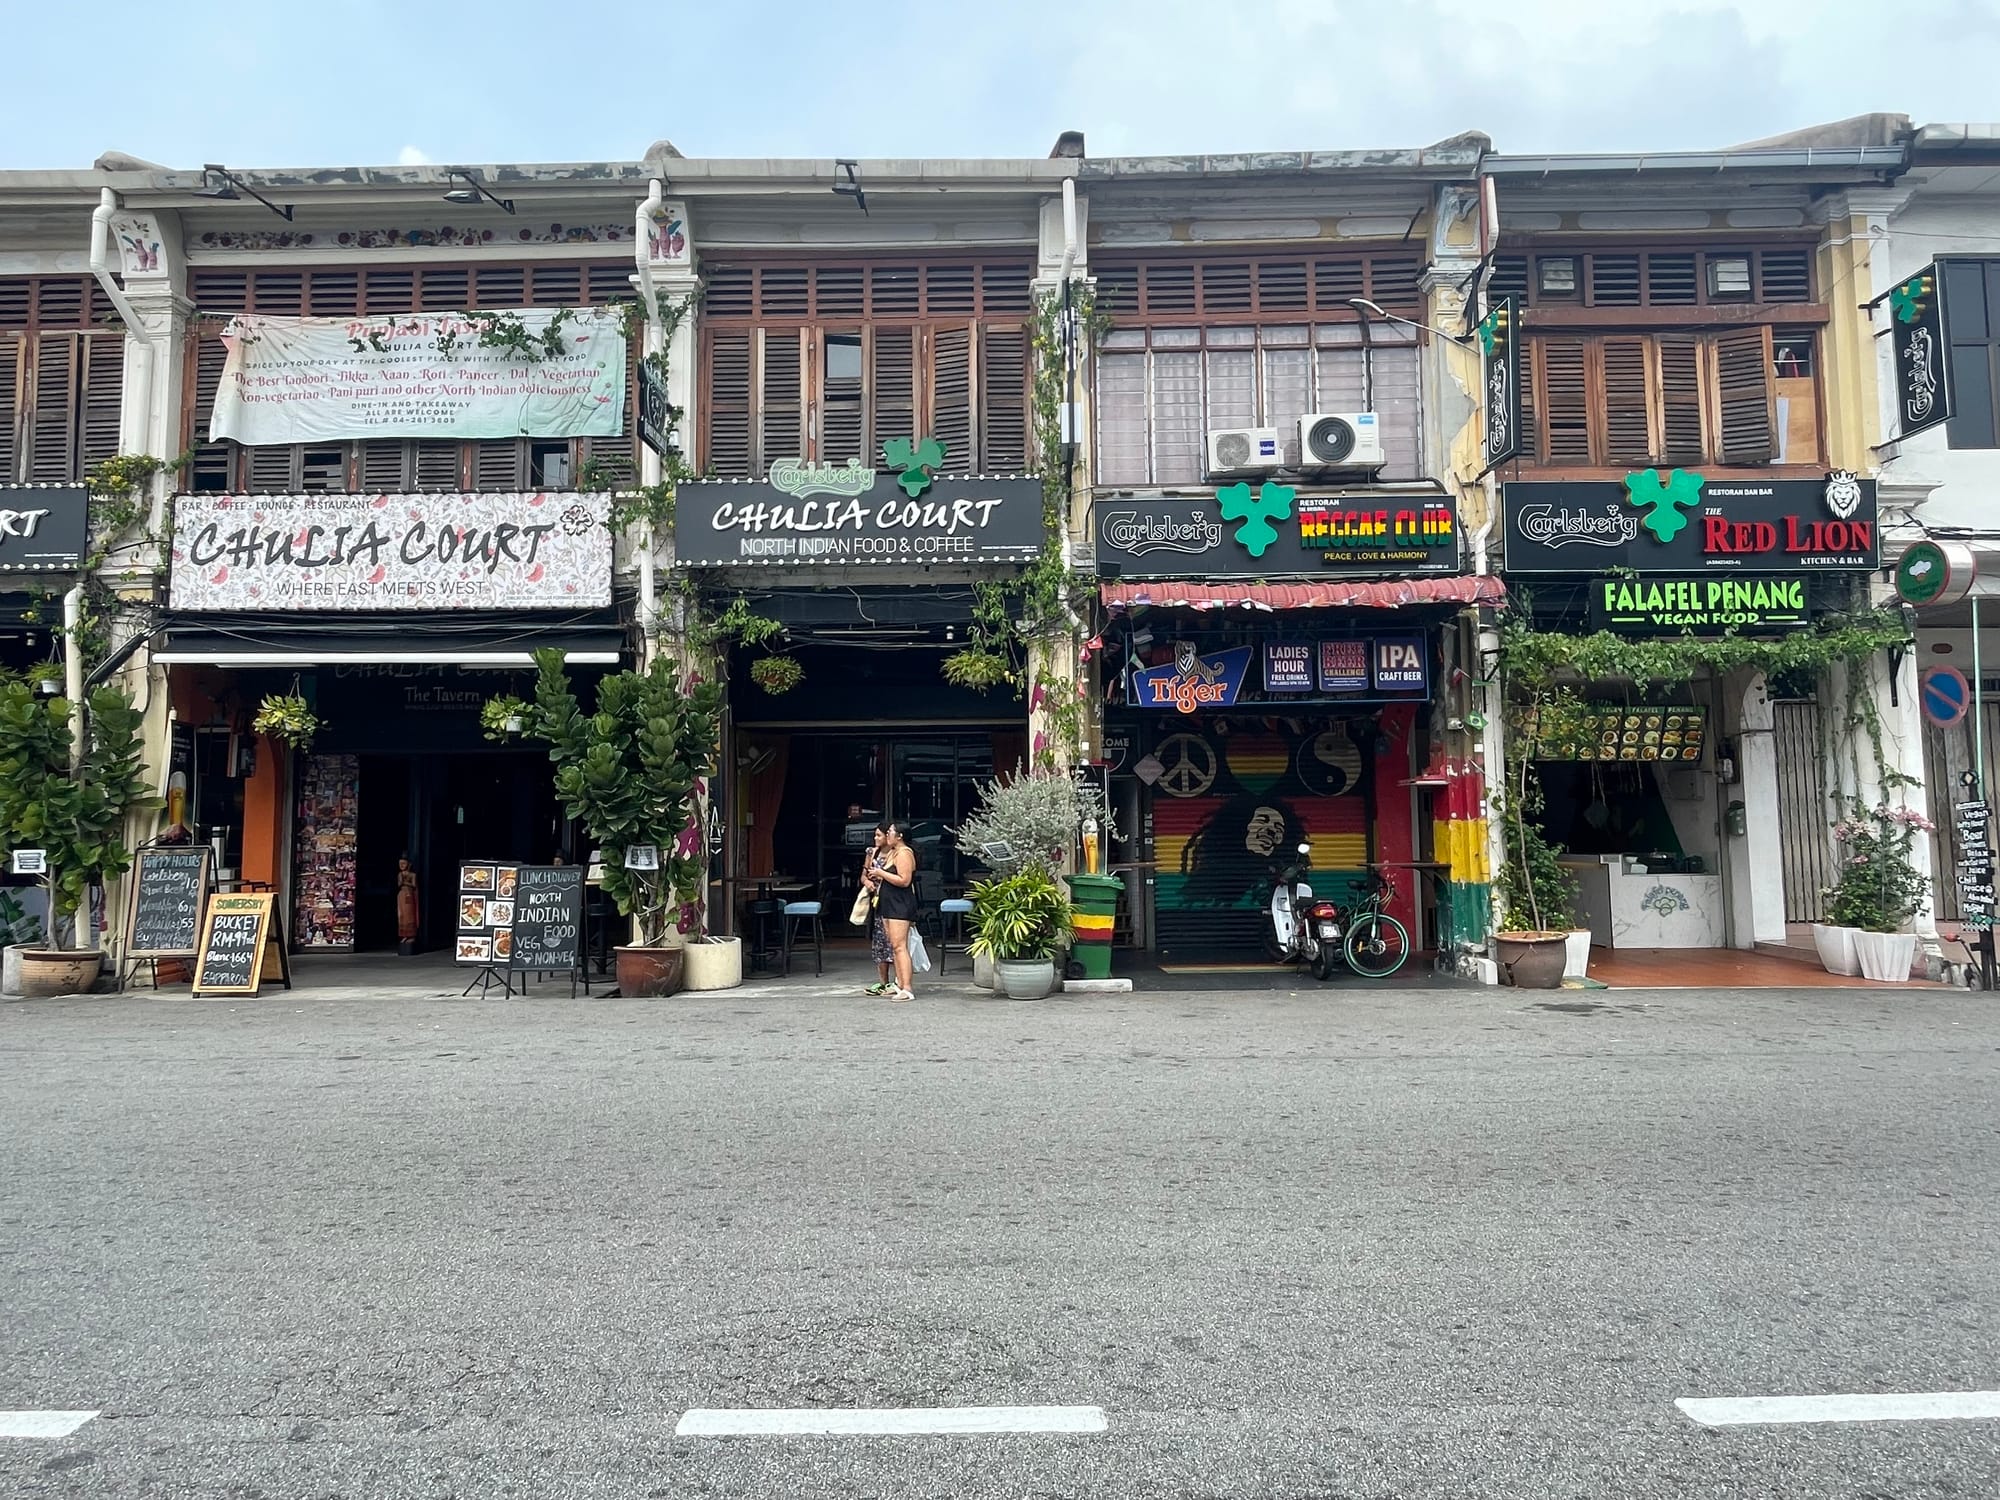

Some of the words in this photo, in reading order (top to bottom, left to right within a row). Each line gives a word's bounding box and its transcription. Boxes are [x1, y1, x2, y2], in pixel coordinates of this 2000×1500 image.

[376, 343, 422, 352] HULIA
[246, 361, 273, 369] SPICE
[379, 356, 423, 364] COOLEST
[563, 353, 587, 362] FOOD
[256, 374, 279, 387] Best
[283, 373, 329, 386] Tandoori
[337, 370, 368, 383] Tikka
[378, 368, 410, 380] Naan
[419, 368, 446, 380] Roti
[457, 368, 498, 381] Paneer
[508, 367, 529, 379] Dal
[539, 367, 600, 383] Vegetarian
[1904, 327, 1936, 422] Carlsberg
[237, 388, 320, 404] Non-vegetarian
[328, 386, 353, 399] Pani
[355, 386, 379, 400] puri
[381, 384, 403, 396] and
[405, 384, 437, 396] other
[439, 384, 476, 397] North
[479, 383, 516, 395] Indian
[519, 383, 592, 396] deliciousness
[1490, 359, 1508, 455] Carlsberg
[769, 457, 876, 498] Carlsberg
[1708, 488, 1744, 496] RESTORAN
[1744, 488, 1759, 496] DAN
[1759, 488, 1773, 496] BAR
[181, 502, 201, 510] BAR
[212, 501, 245, 510] COFFEE
[255, 501, 294, 510] LOUNGE
[304, 500, 371, 510] RESTAURANT
[1299, 499, 1340, 507] RESTORAN
[711, 498, 871, 533] CHULIA
[875, 499, 1003, 535] COURT
[1705, 507, 1722, 516] THE
[1102, 510, 1223, 557] Carlsberg
[1299, 510, 1389, 549] REGGAE
[1394, 508, 1453, 548] CLUB
[1518, 503, 1638, 550] Carlsberg
[1703, 516, 1777, 553] RED
[1784, 515, 1871, 552] LION
[190, 520, 390, 570] CHULIA
[400, 520, 555, 575] COURT
[740, 537, 797, 556] NORTH
[799, 537, 852, 555] INDIAN
[854, 537, 898, 554] FOOD
[899, 537, 911, 553] &
[914, 536, 974, 553] COFFEE
[1324, 552, 1352, 560] PEACE
[1357, 552, 1378, 560] LOVE
[1387, 551, 1428, 560] HARMONY
[1800, 557, 1838, 565] KITCHEN
[1847, 557, 1864, 565] BAR
[276, 582, 334, 597] WHERE
[338, 582, 377, 596] EAST
[382, 581, 436, 596] MEETS
[441, 581, 485, 596] WEST
[1604, 582, 1702, 612] FALAFEL
[1707, 580, 1804, 610] PENANG
[1651, 613, 1708, 625] VEGAN
[1713, 612, 1759, 624] FOOD
[1269, 646, 1309, 659] LADIES
[1380, 645, 1420, 669] IPA
[1274, 660, 1305, 673] HOUR
[1324, 668, 1365, 677] CHALLENGE
[1379, 671, 1402, 681] CRAFT
[1403, 671, 1422, 681] BEER
[404, 686, 430, 703] The
[433, 686, 481, 703] Tavern
[1149, 675, 1228, 713] Tiger
[1964, 810, 1989, 820] Vegan
[1963, 829, 1984, 841] Beer
[143, 855, 170, 868] HAPPY
[186, 877, 199, 889] 10
[520, 871, 551, 885] LUNCH
[216, 898, 265, 910] SOMERSBY
[529, 892, 562, 905] NORTH
[214, 914, 261, 931] BUCKET
[518, 907, 570, 923] INDIAN
[543, 925, 576, 938] FOOD
[515, 935, 541, 950] VEG
[534, 950, 574, 966] NON-VEG
